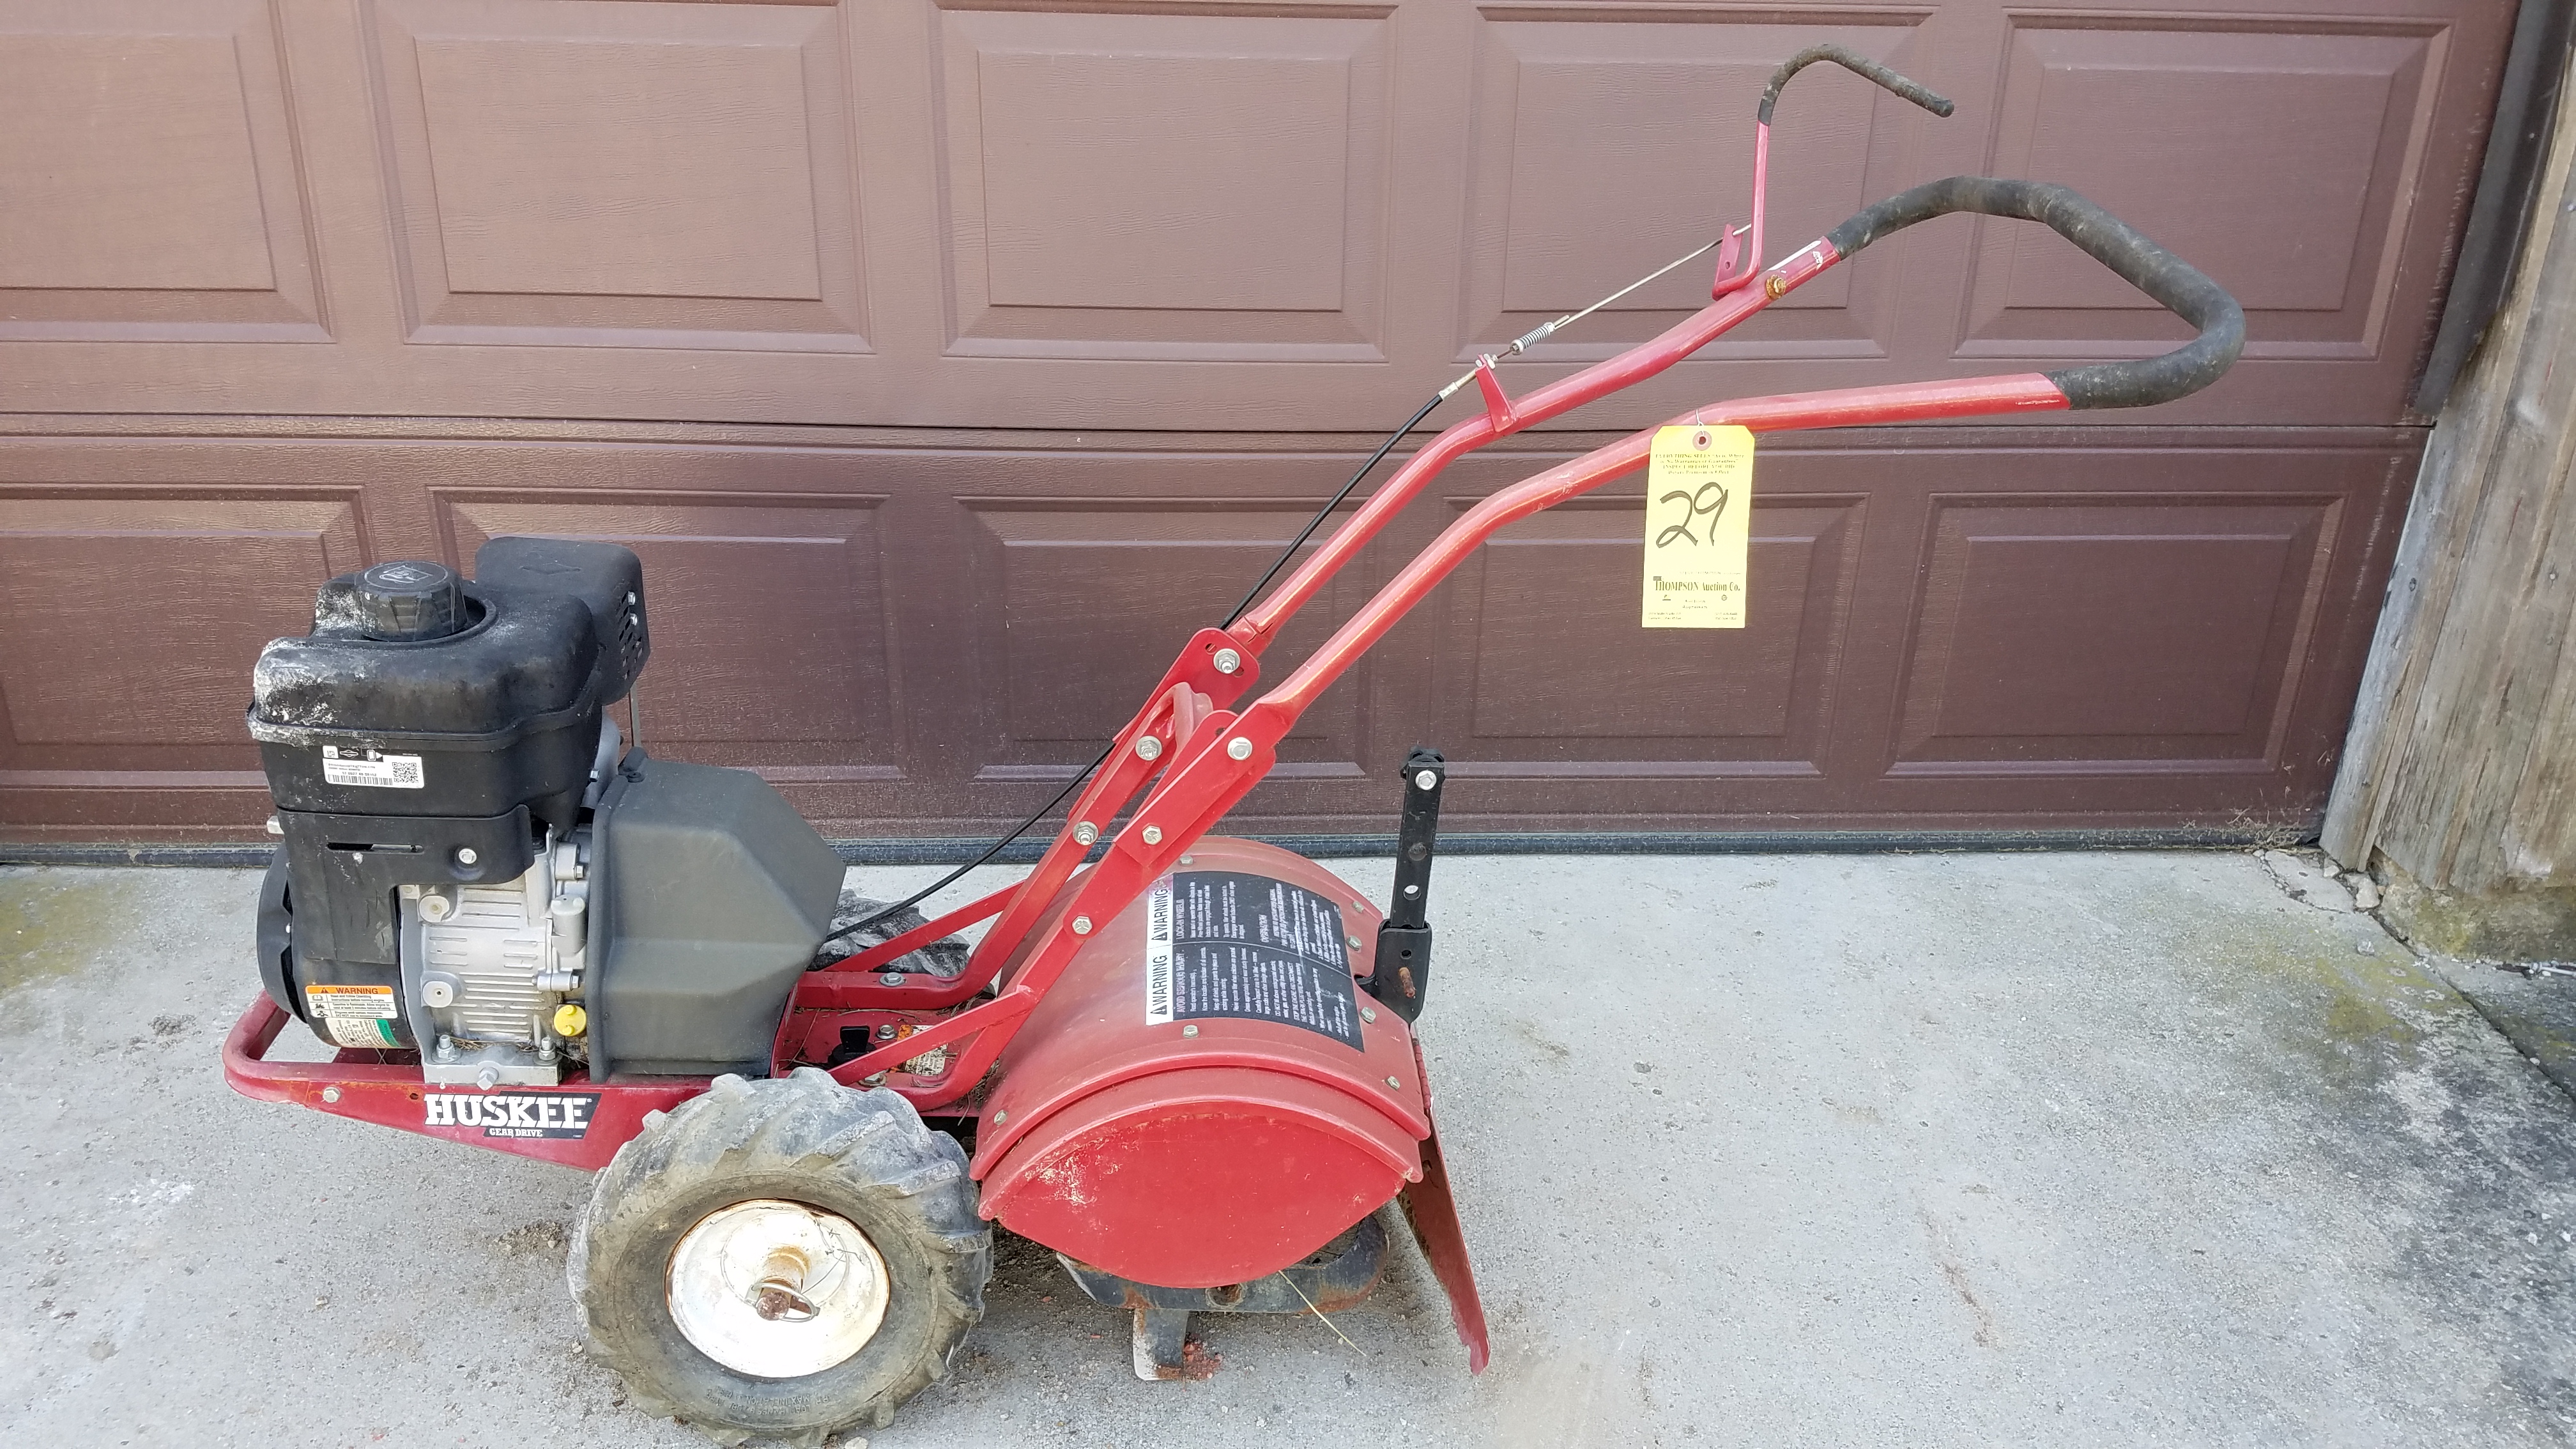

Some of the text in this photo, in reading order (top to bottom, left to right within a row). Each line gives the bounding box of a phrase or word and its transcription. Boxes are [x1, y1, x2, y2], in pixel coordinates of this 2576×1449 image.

[1656, 482, 1728, 548] 29
[1654, 579, 1740, 591] THOMPSON Auction Co.
[1154, 888, 1168, 930] WARNING
[1153, 954, 1167, 1004] WARNING
[1176, 972, 1185, 995] SERIOUS
[1176, 996, 1185, 1013] AVOID
[424, 1094, 588, 1128] HUSKEE
[489, 1128, 543, 1137] GEAR DRIVE
